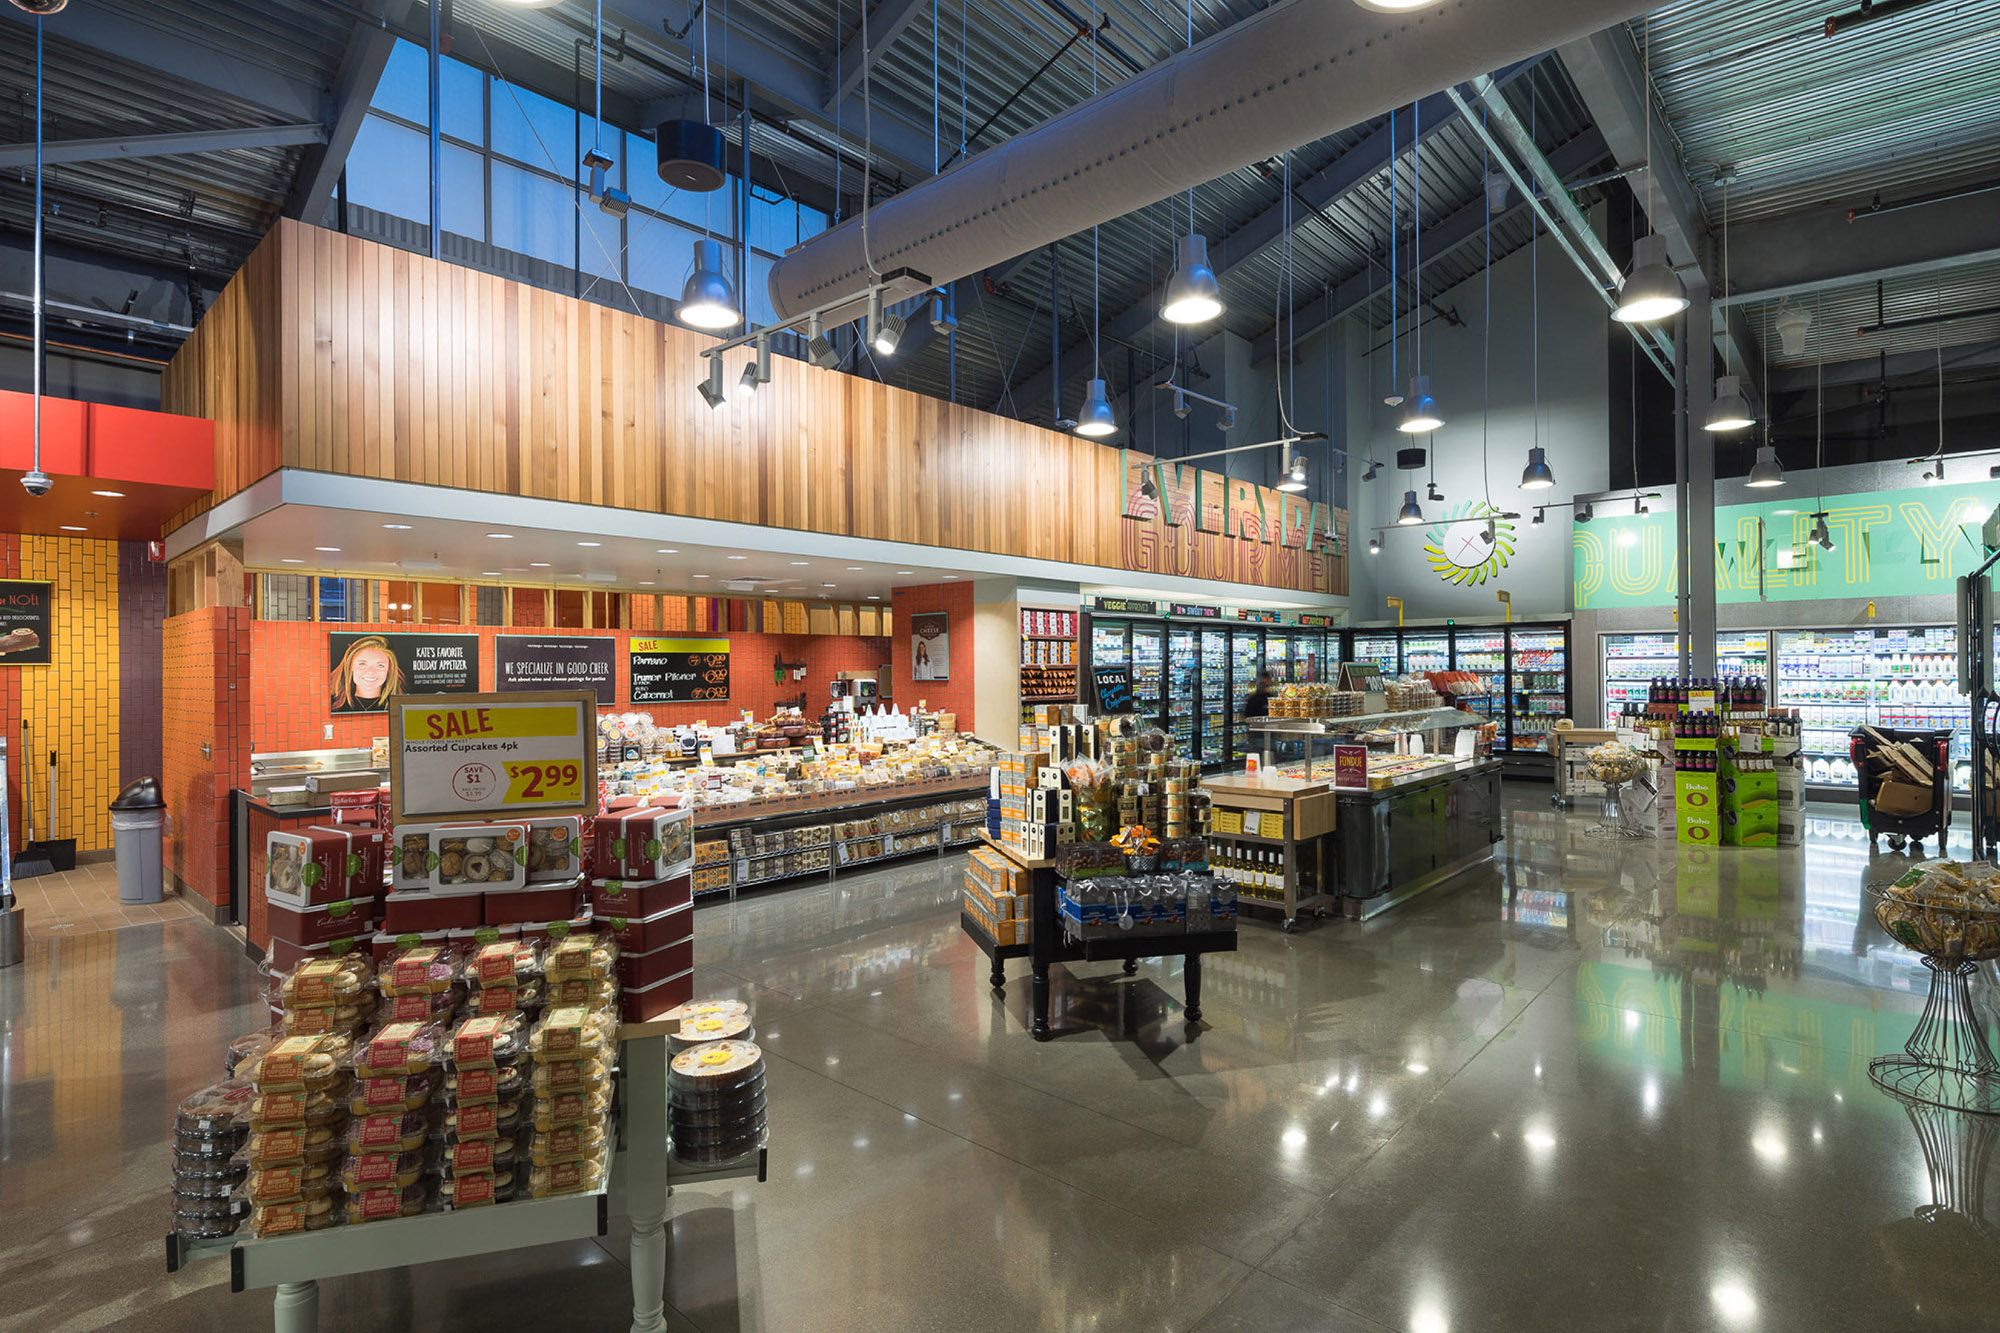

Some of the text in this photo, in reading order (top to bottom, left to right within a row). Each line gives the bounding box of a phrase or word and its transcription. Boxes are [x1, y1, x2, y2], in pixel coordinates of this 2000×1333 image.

[1122, 488, 1349, 597] GOURMET
[1104, 601, 1126, 611] VEGGIE
[638, 640, 658, 651] SALE
[416, 647, 463, 658] KATE'S FAVORITE
[413, 660, 467, 671] HOLIDAY APPETIZER
[505, 662, 609, 675] WE SPECIALIZE IN GOOD CHEER
[1096, 674, 1126, 684] LOCAL
[426, 708, 493, 740] SALE
[405, 741, 518, 753] Assorted Cupcakes 4pk
[1339, 756, 1362, 767] FONDUE
[467, 774, 480, 783] $1
[1685, 783, 1709, 791] Bubo
[1687, 816, 1710, 825] Bubo
